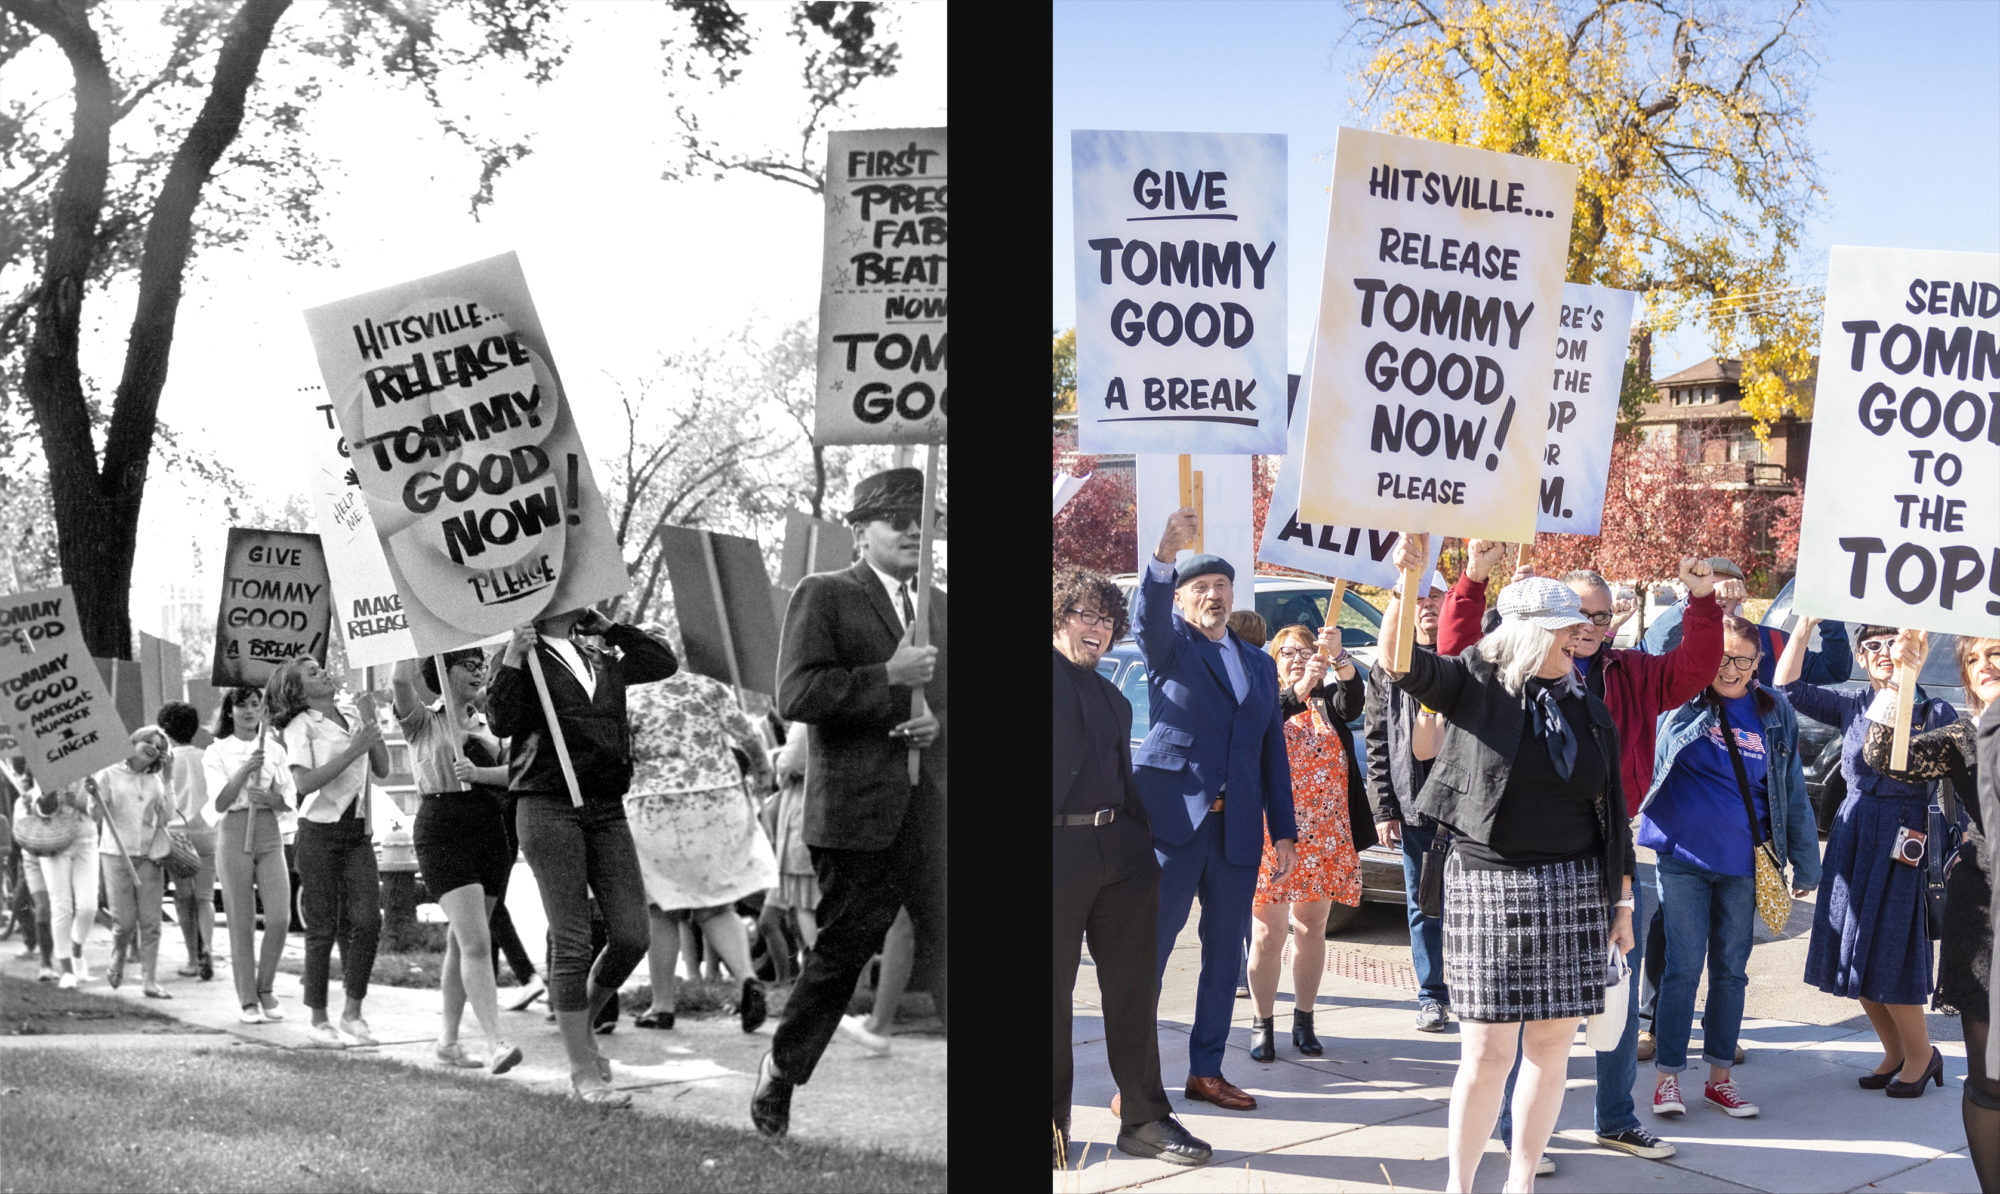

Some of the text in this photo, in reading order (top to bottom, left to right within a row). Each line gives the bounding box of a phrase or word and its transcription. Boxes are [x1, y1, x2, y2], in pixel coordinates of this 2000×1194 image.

[848, 141, 939, 178] FIRST
[1133, 168, 1228, 211] GIVE
[1369, 164, 1555, 219] HITSVILLE...
[873, 215, 947, 249] FAB
[850, 251, 947, 286] BEAT
[1088, 237, 1276, 290] TOMMY
[1379, 227, 1521, 281] RELEASE
[885, 295, 947, 320] NOW
[1353, 278, 1534, 350] TOMMY
[1905, 278, 2000, 319] SEND
[1110, 298, 1254, 349] GOOD
[364, 332, 530, 408] RELEASE
[1365, 340, 1505, 405] GOOD
[1553, 368, 1592, 394] THE
[1104, 376, 1257, 412] A BREAK
[353, 384, 542, 472] TOMMY
[1858, 382, 2000, 446] GOO
[1370, 395, 1516, 472] NOW!
[403, 445, 550, 513] GOOD
[1907, 449, 1962, 487] TO
[1377, 472, 1467, 505] PLEASE
[332, 492, 354, 524] HELP
[347, 510, 363, 531] ME
[1894, 494, 1967, 533] THE
[248, 545, 302, 567] GIVE
[229, 577, 322, 604] TOMMY
[467, 554, 556, 602] PLEASE
[227, 607, 308, 632] GOOD
[353, 594, 402, 618] MAKE
[226, 640, 239, 655] A
[0, 653, 69, 697] TOMMY
[15, 675, 78, 711] GOOD
[34, 706, 91, 738] NUMBER
[47, 731, 99, 763] SINGER
